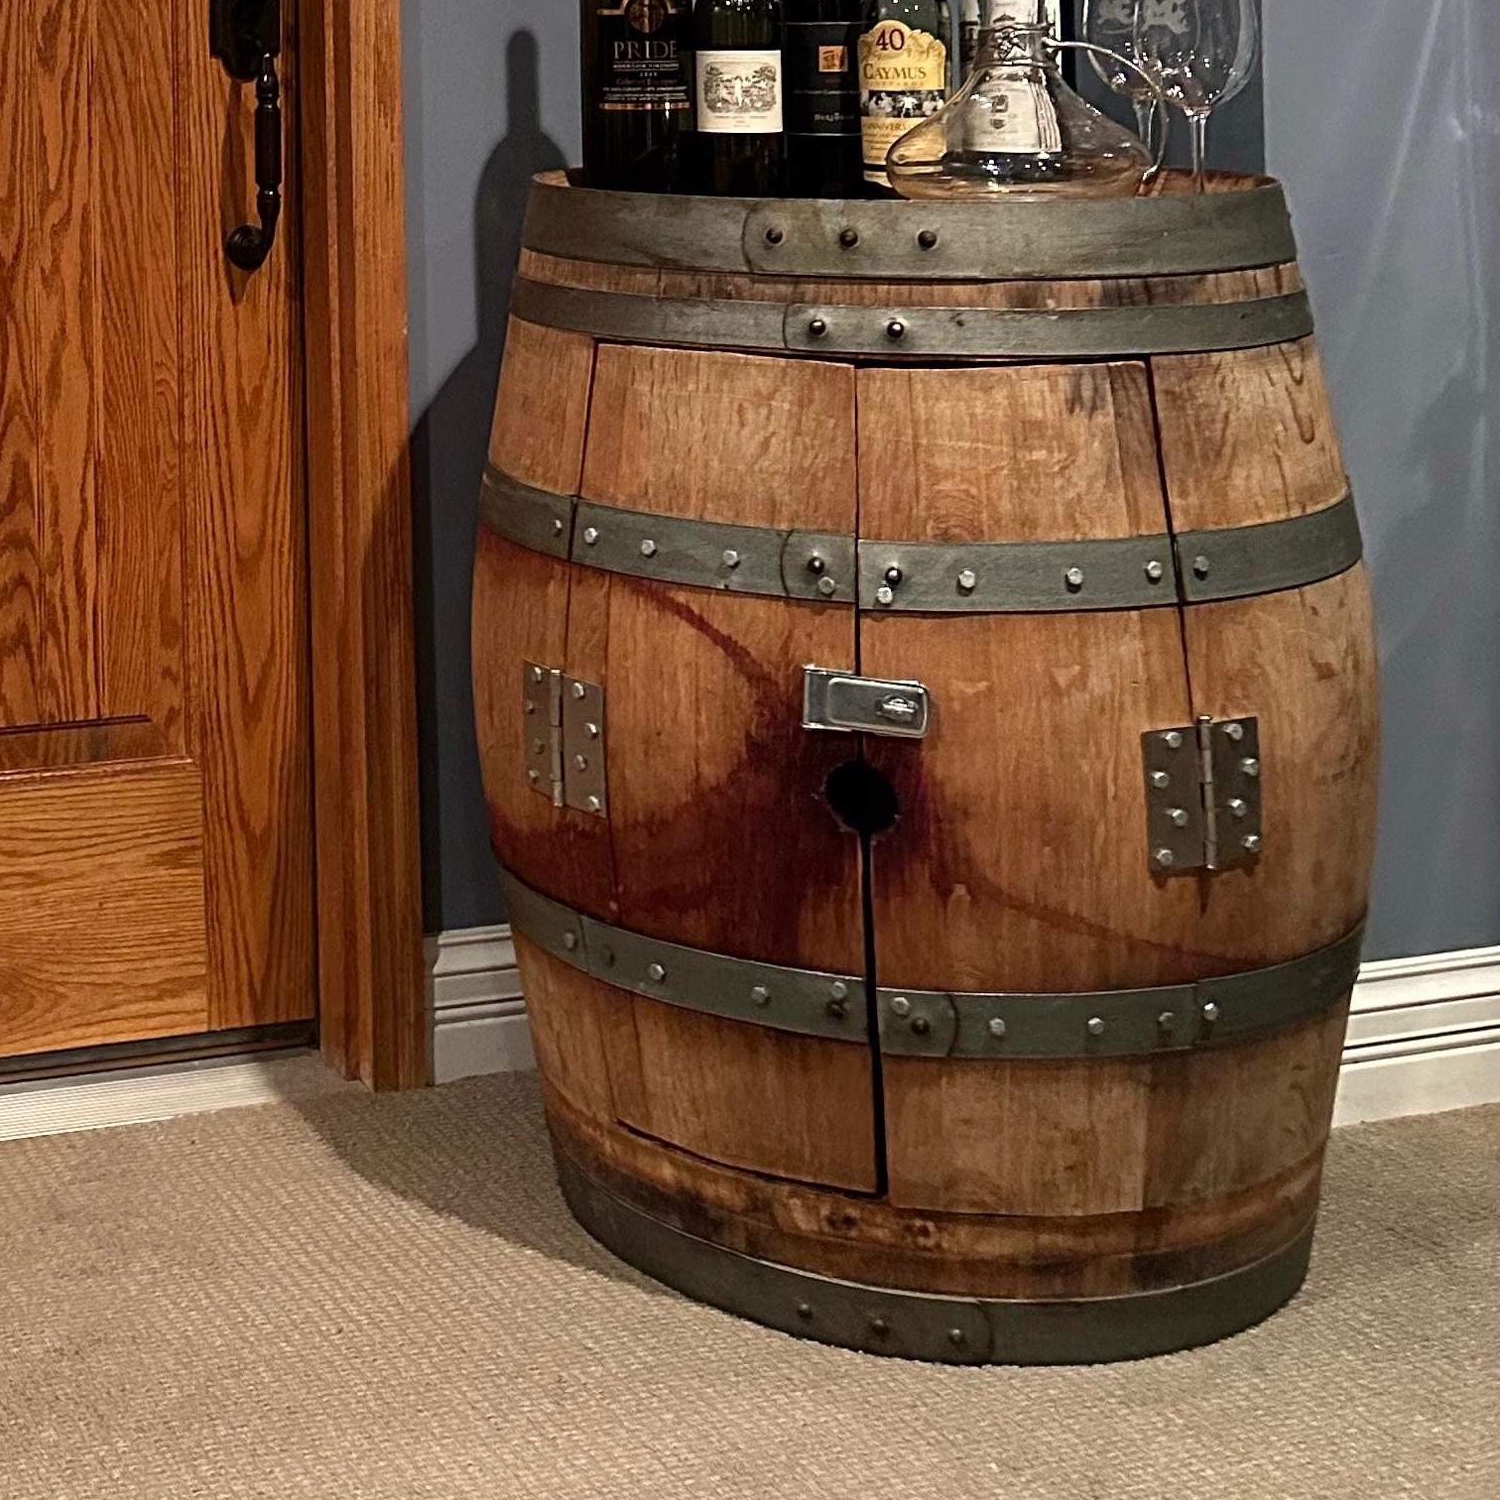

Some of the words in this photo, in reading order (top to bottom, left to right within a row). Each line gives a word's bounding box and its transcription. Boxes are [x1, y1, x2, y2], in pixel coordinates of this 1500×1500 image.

[876, 28, 905, 51] 40
[614, 40, 678, 59] PRIDE
[863, 62, 927, 80] CAYMUS
